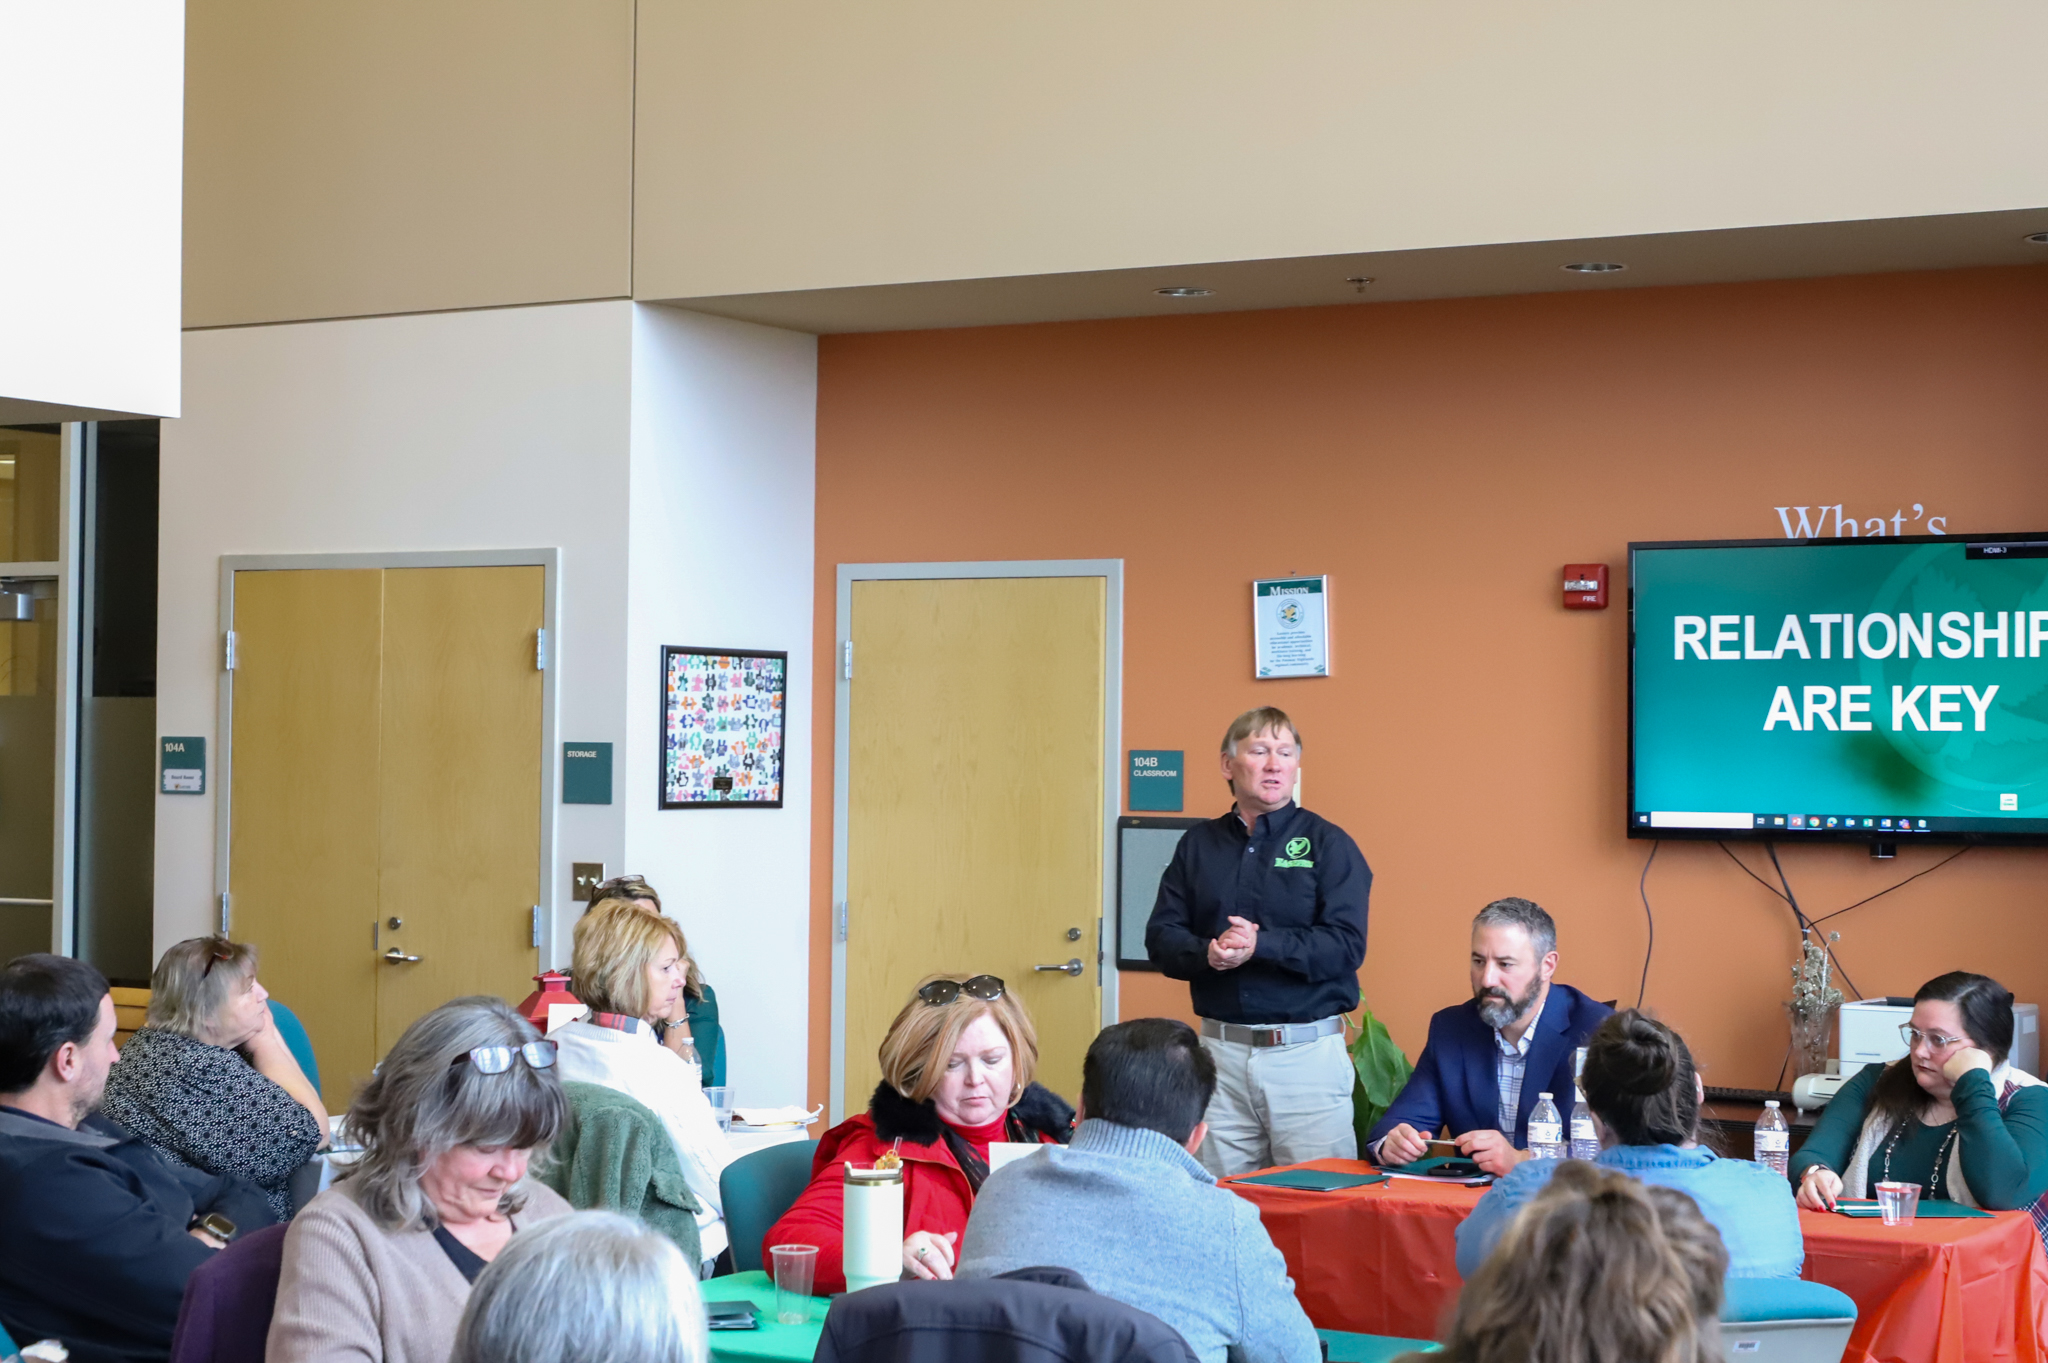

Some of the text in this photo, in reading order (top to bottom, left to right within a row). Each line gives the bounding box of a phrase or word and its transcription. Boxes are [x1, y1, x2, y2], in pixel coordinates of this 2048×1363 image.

[1774, 503, 1947, 538] What's
[1763, 685, 2000, 731] ARE KEY
[164, 743, 185, 752] 104A
[567, 750, 597, 758] STORAGE
[1133, 757, 1158, 767] 104B
